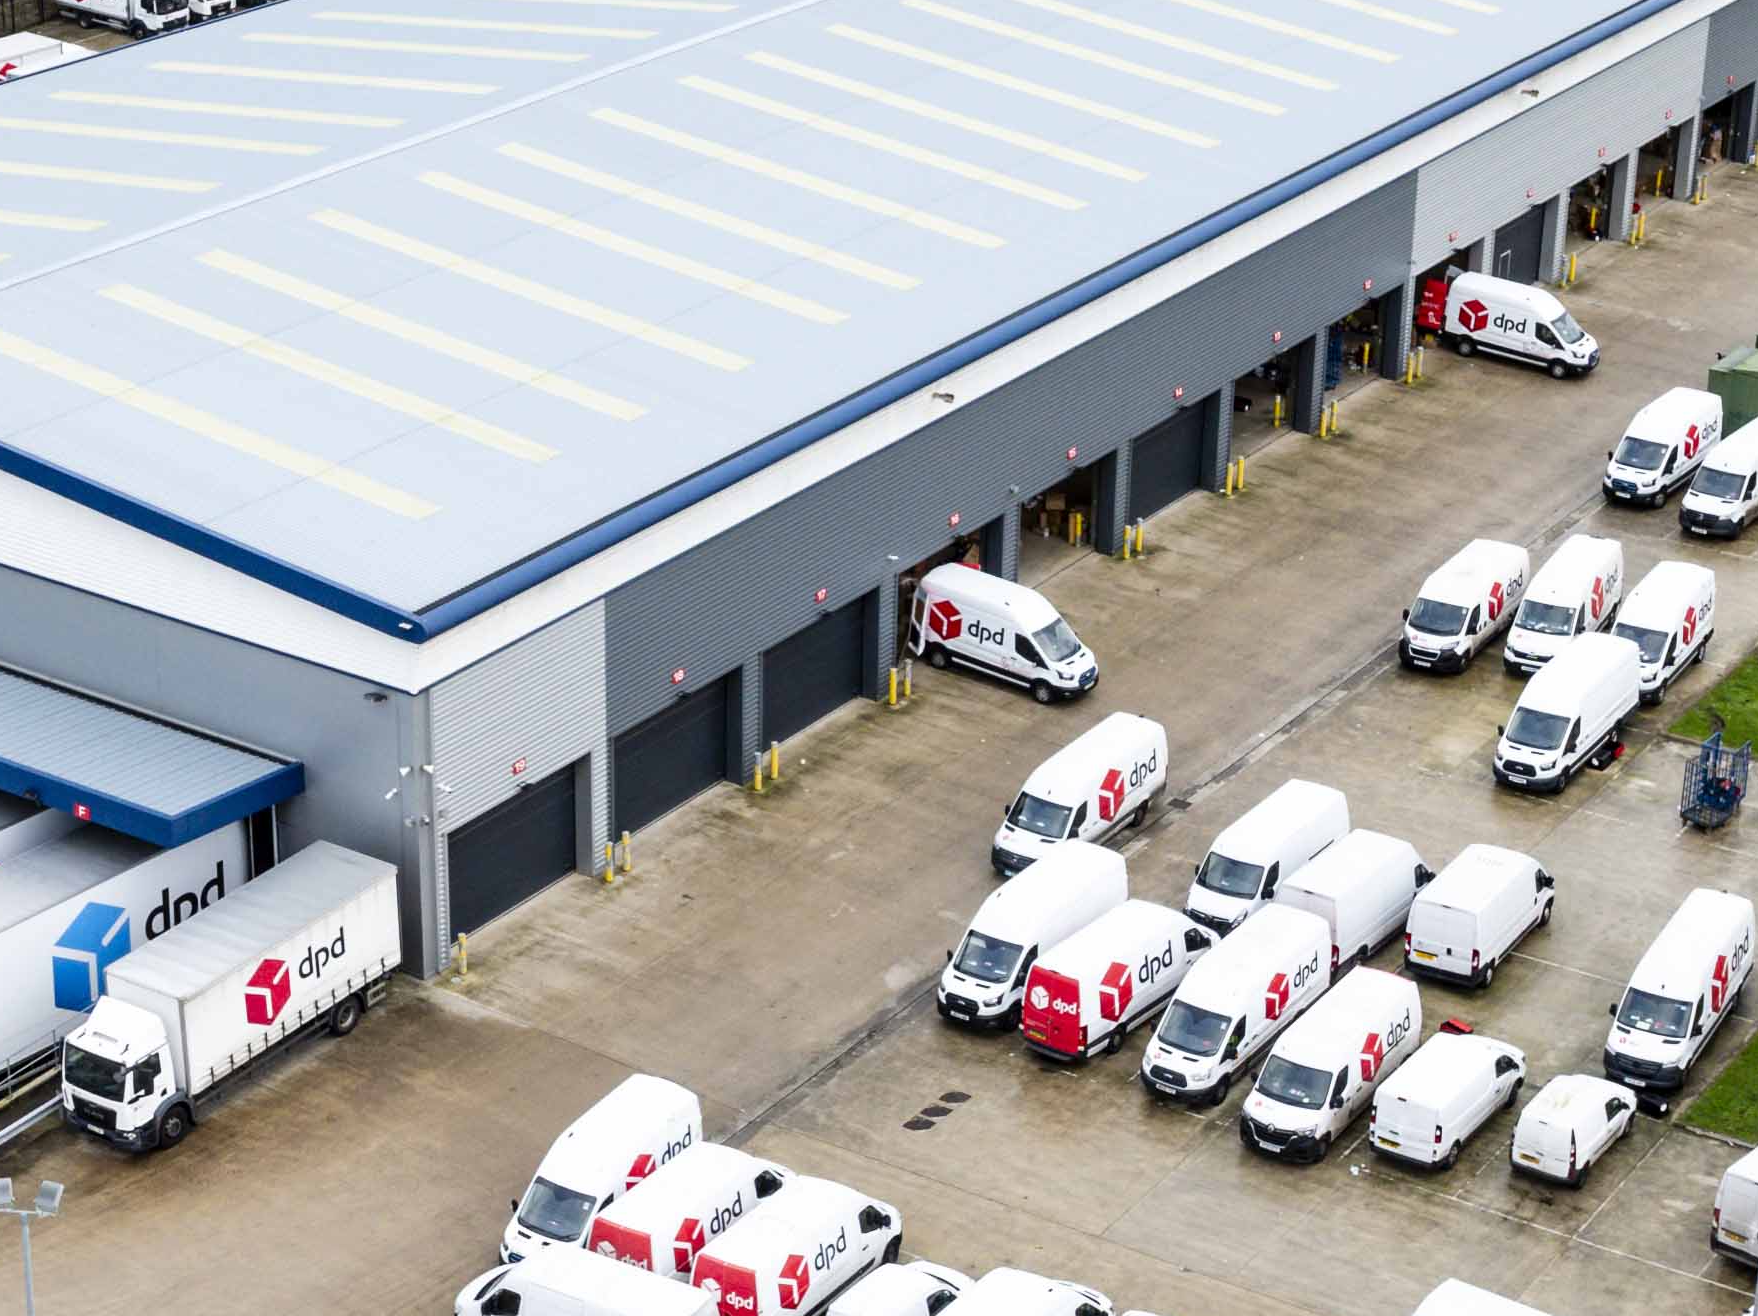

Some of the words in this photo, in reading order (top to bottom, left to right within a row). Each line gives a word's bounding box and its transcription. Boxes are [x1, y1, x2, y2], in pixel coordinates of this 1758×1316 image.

[1494, 313, 1527, 334] dpd
[1506, 569, 1523, 596] dpd
[968, 620, 1005, 646] dpd
[1129, 748, 1157, 787] dpd
[78, 805, 87, 817] F
[145, 860, 226, 941] dpd
[298, 926, 346, 978] dpd
[1139, 940, 1173, 984] dpd
[1732, 926, 1749, 972] dpd
[1293, 950, 1319, 988] dpd
[1052, 997, 1078, 1016] dpd
[1387, 1008, 1411, 1047] dpd
[710, 1191, 743, 1234] dpd
[815, 1226, 847, 1271] dpd
[725, 1291, 754, 1311] dpd
